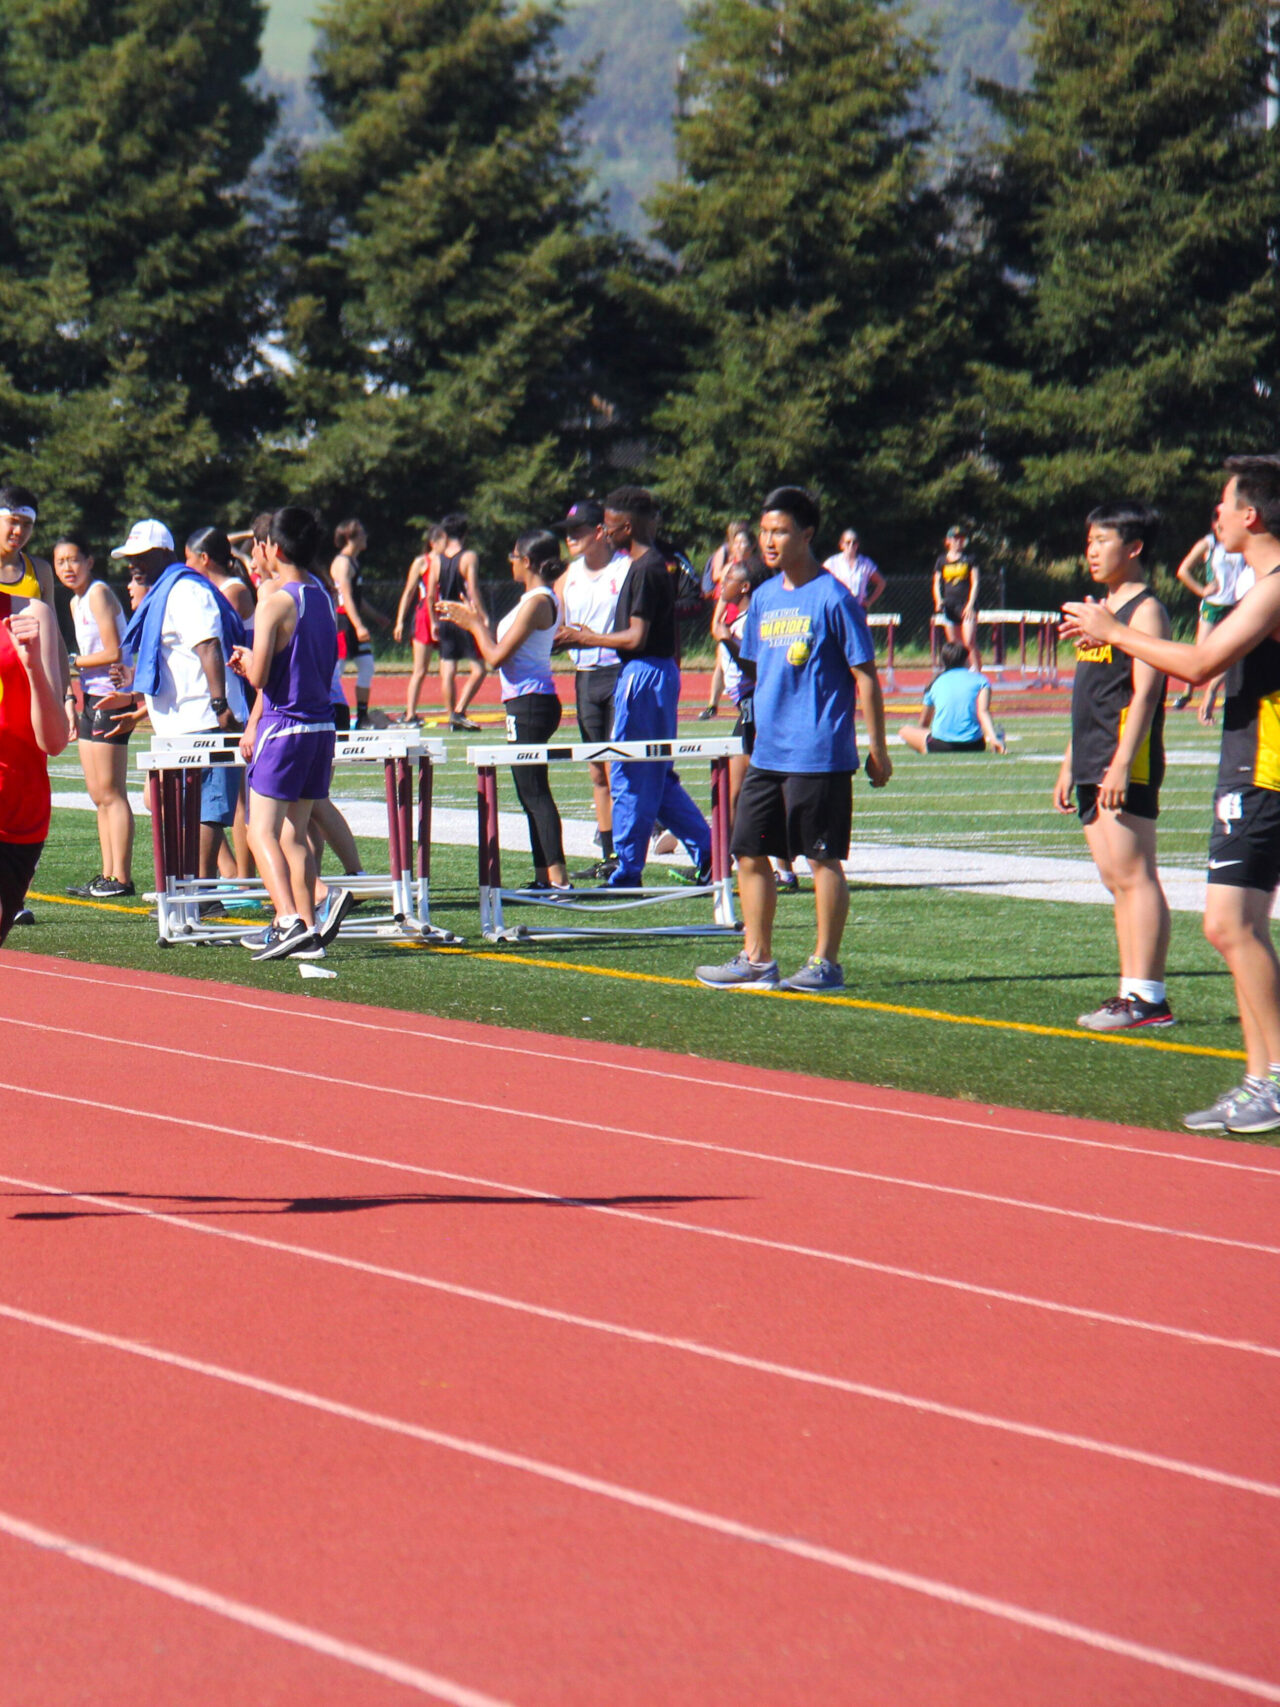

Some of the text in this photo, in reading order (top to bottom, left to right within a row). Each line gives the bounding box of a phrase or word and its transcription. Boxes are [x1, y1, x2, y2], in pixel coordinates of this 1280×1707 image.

[760, 617, 811, 639] WARRIORS
[193, 740, 216, 748] GILL
[342, 746, 366, 755] GILL
[678, 744, 703, 753] GILL
[178, 755, 202, 763] GILL
[516, 752, 541, 760] GILL
